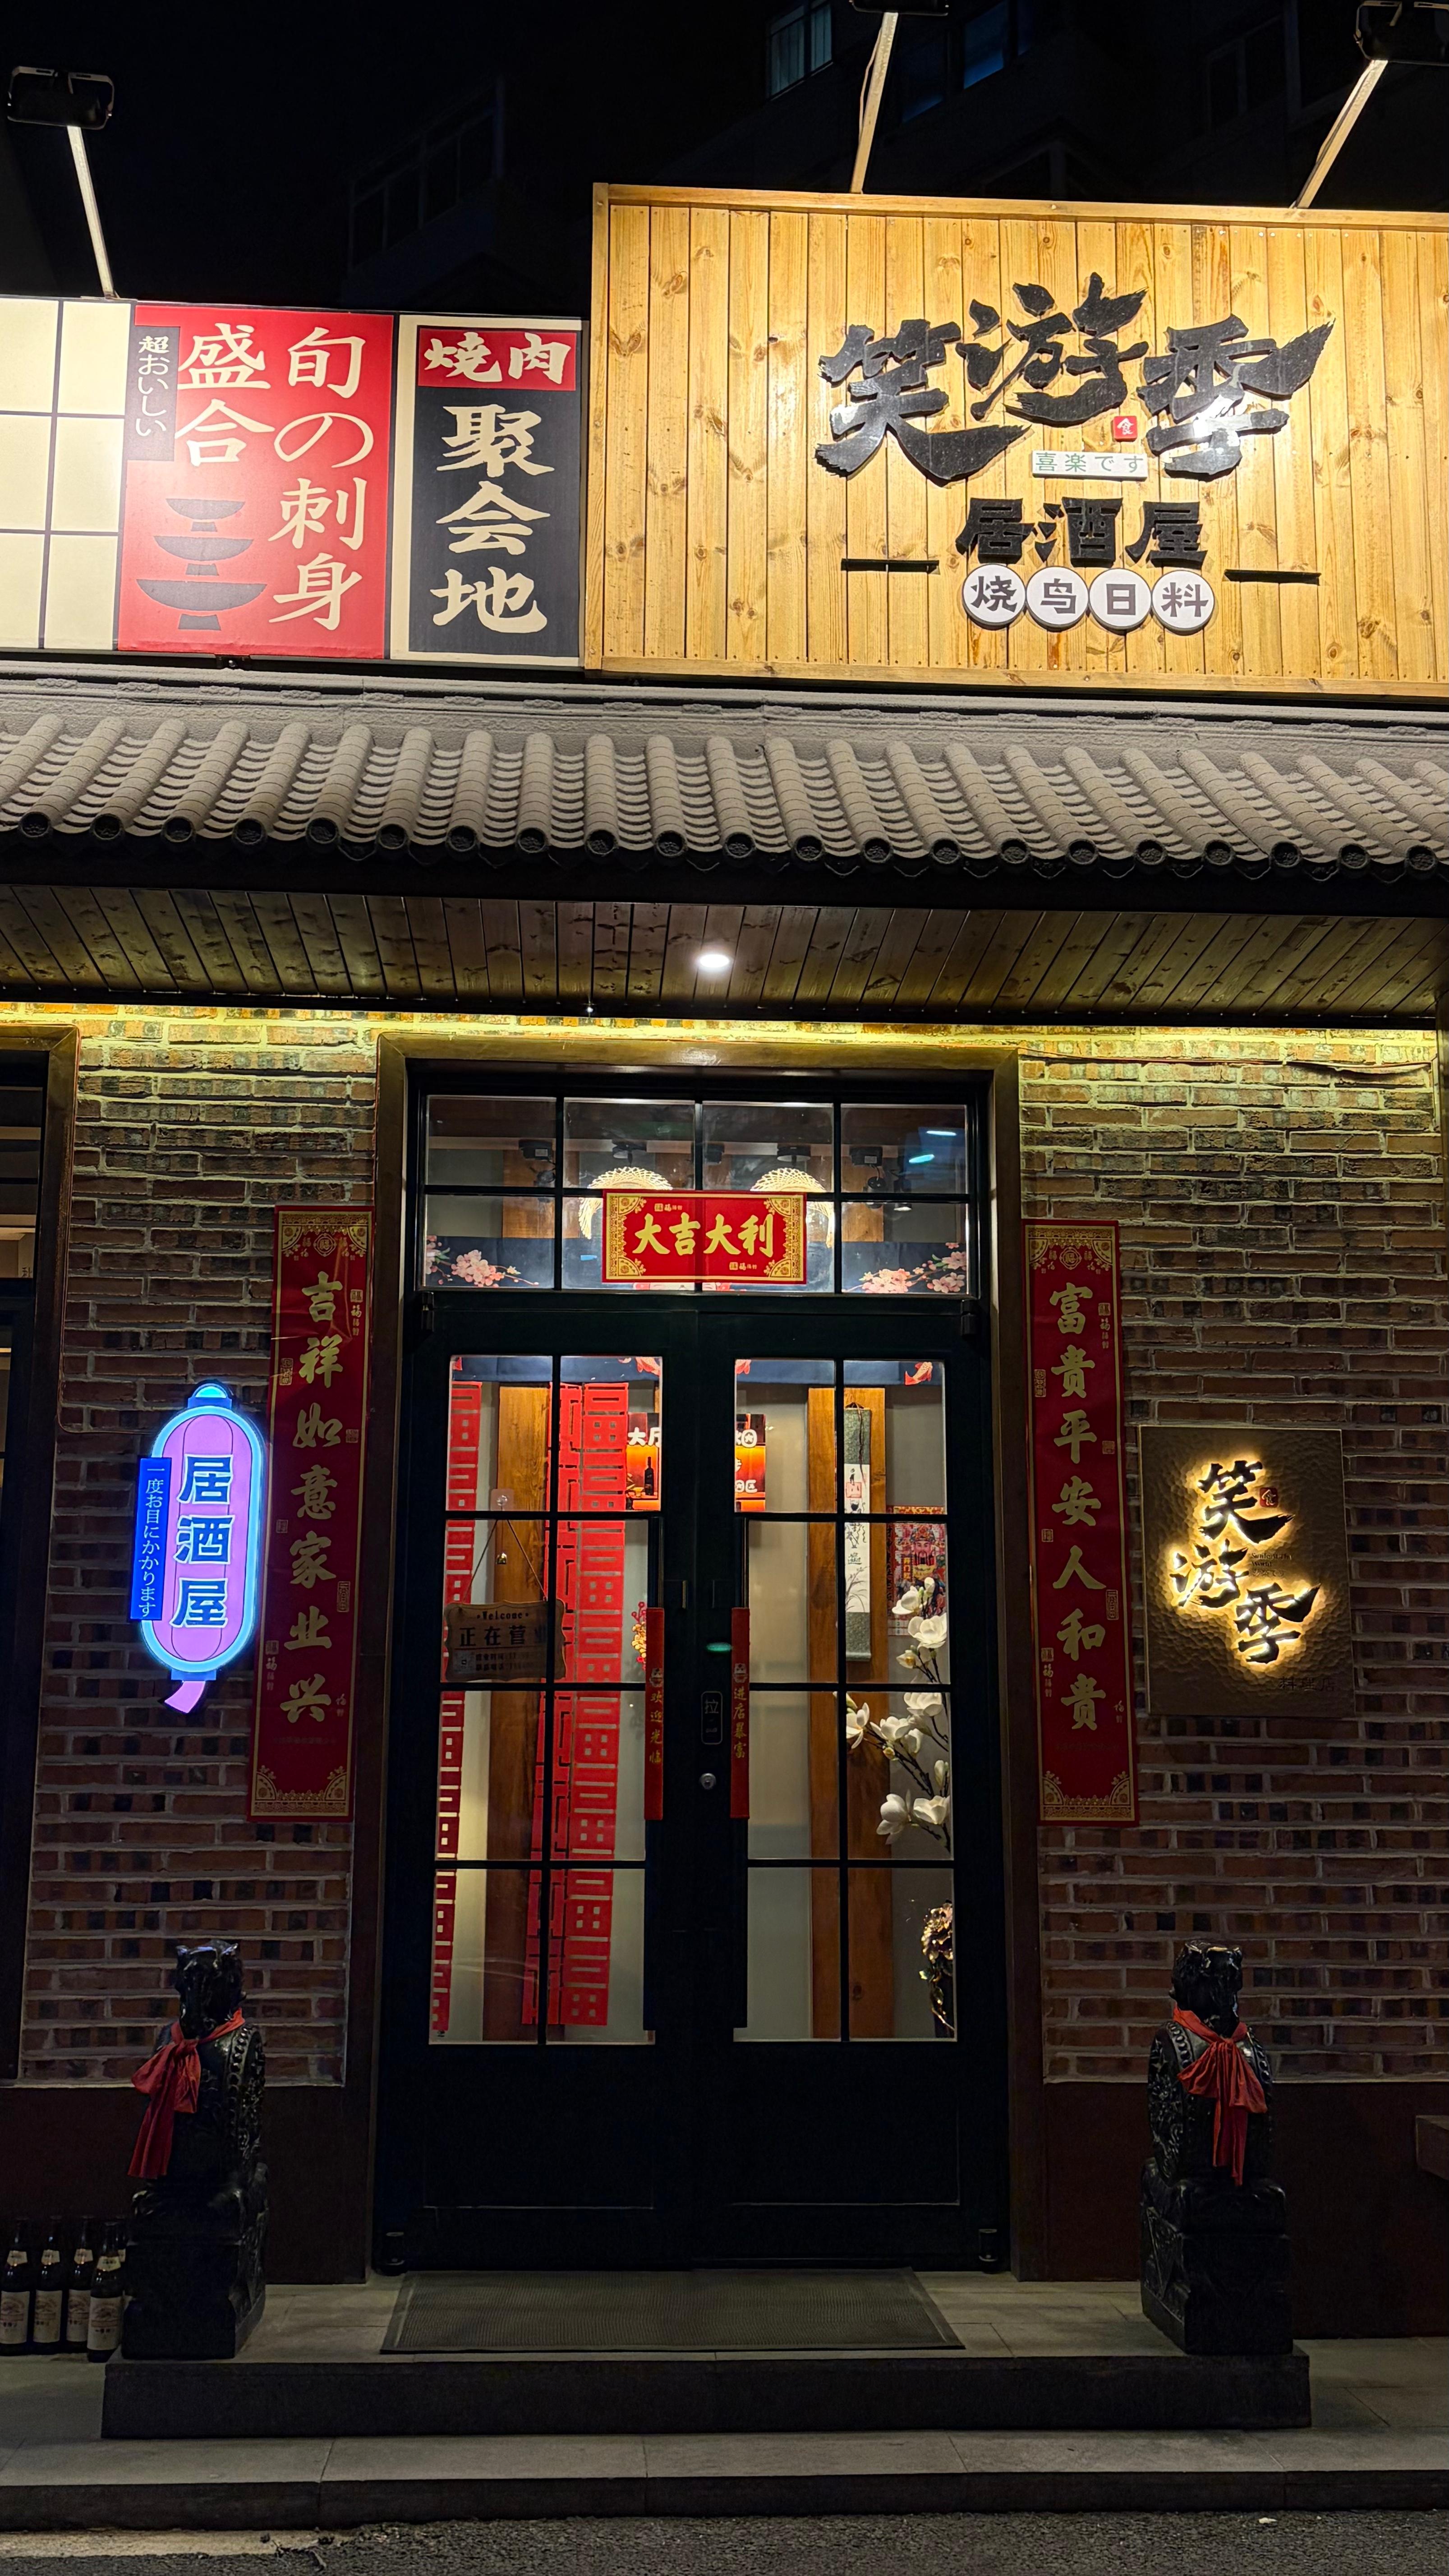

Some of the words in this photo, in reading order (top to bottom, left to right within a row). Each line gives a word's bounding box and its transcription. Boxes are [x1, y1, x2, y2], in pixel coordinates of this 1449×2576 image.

[135, 336, 170, 437] 超おいしい
[175, 323, 276, 467] 盛合
[268, 327, 374, 631] 旬の刺身
[1036, 452, 1144, 473] 喜楽です
[430, 405, 556, 634] 聚会地
[956, 497, 1209, 568] 居酒屋
[970, 575, 1209, 617] 烧鸟日料
[632, 1212, 773, 1258] 大吉大利
[138, 1468, 166, 1618] 一度お目にかかります
[170, 1454, 235, 1628] 居酒屋
[280, 1271, 343, 1723] 吉祥如意家业兴
[1049, 1282, 1107, 1730] 富贵平安人和贵
[649, 1691, 663, 1763] 欢迎光临
[704, 1698, 719, 1714] 拉
[733, 1686, 747, 1758] 进店暴富
